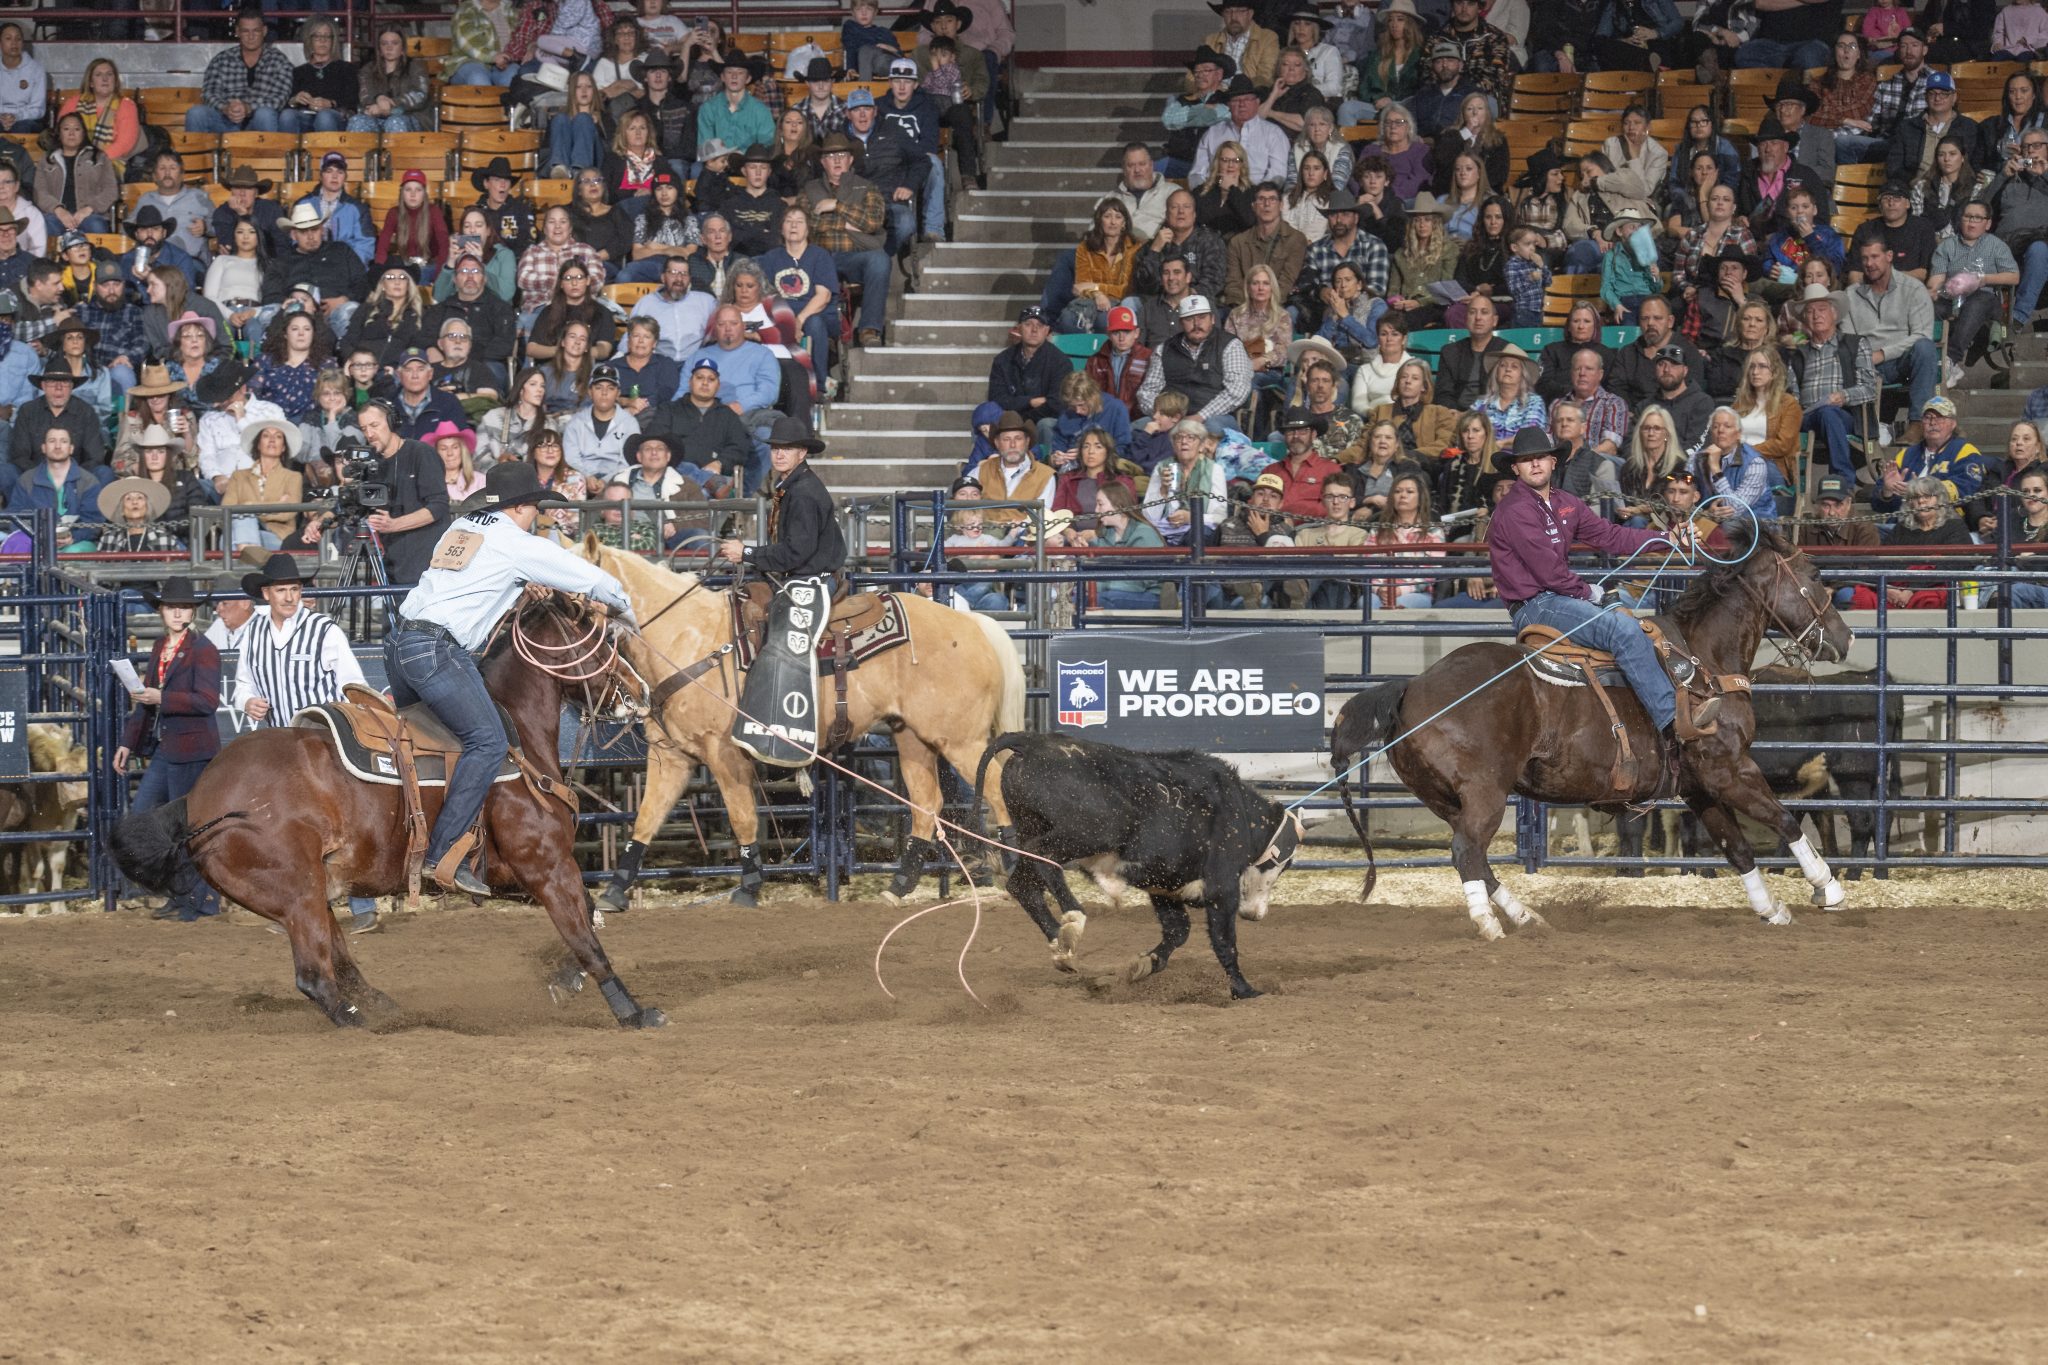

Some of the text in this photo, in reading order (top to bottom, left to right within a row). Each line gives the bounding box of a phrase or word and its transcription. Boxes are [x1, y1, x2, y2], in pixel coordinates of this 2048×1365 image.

[413, 40, 422, 52] 4
[257, 135, 265, 143] 5
[338, 135, 346, 143] 6
[560, 183, 568, 191] 9
[1448, 334, 1456, 343] 5
[1533, 333, 1542, 345] 6
[1618, 331, 1626, 344] 7
[444, 546, 466, 557] 563
[1118, 669, 1264, 692] WE ARE
[1119, 692, 1321, 717] PRORODEO
[743, 721, 816, 744] RAM
[1157, 782, 1185, 810] 92
